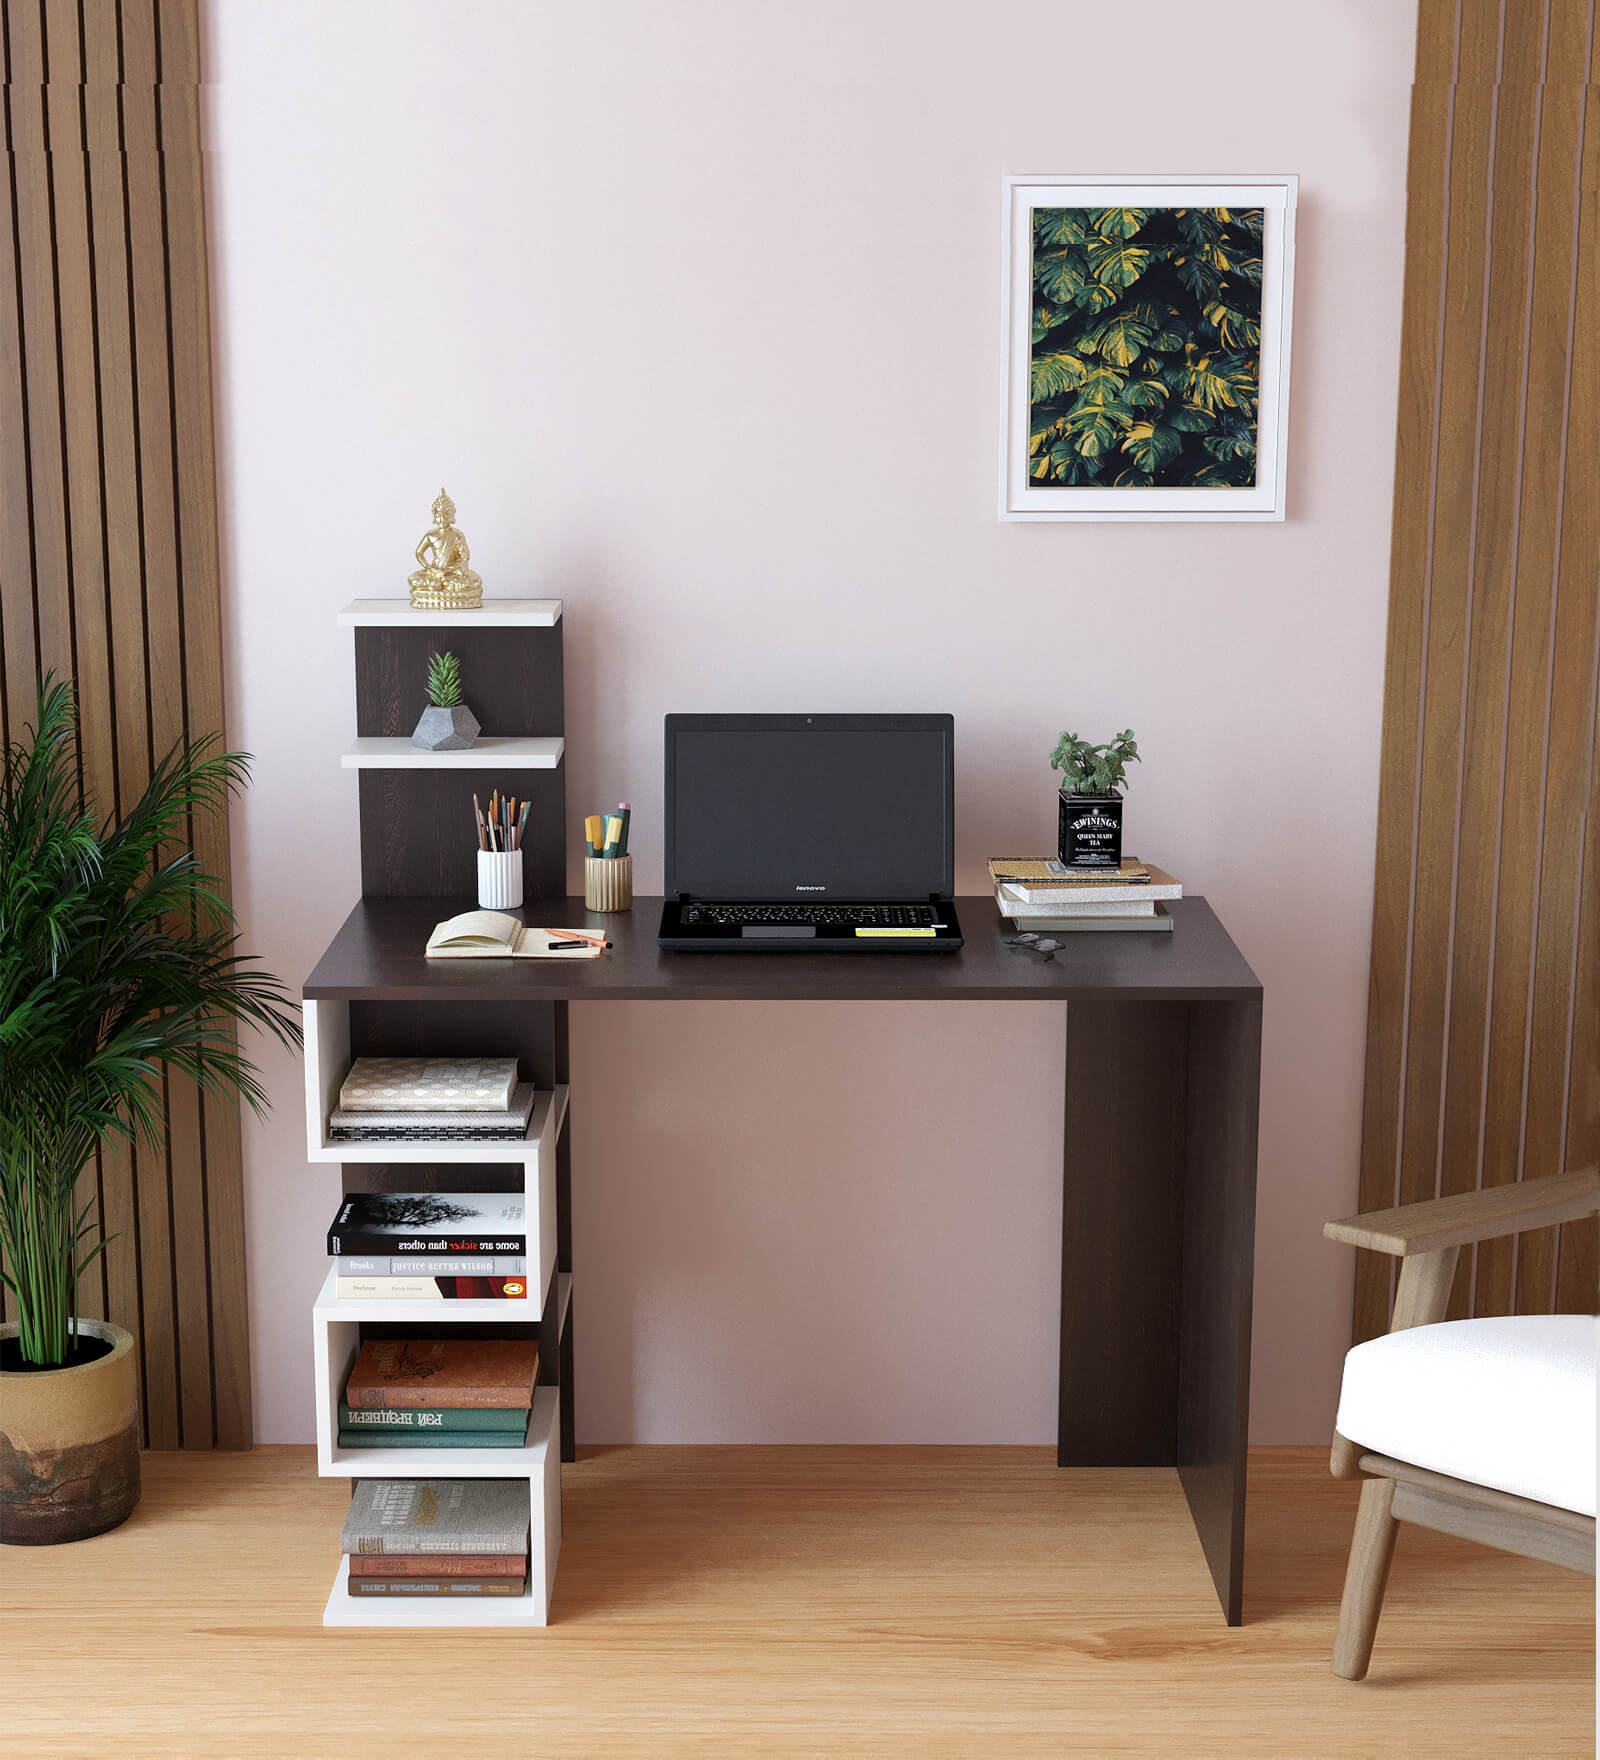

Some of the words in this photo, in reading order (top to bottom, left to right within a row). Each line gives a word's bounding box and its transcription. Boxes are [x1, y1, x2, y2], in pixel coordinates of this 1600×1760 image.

[350, 1260, 376, 1271] Brooks
[462, 1262, 492, 1271] WILSON
[417, 1413, 443, 1427] РЭЙ
